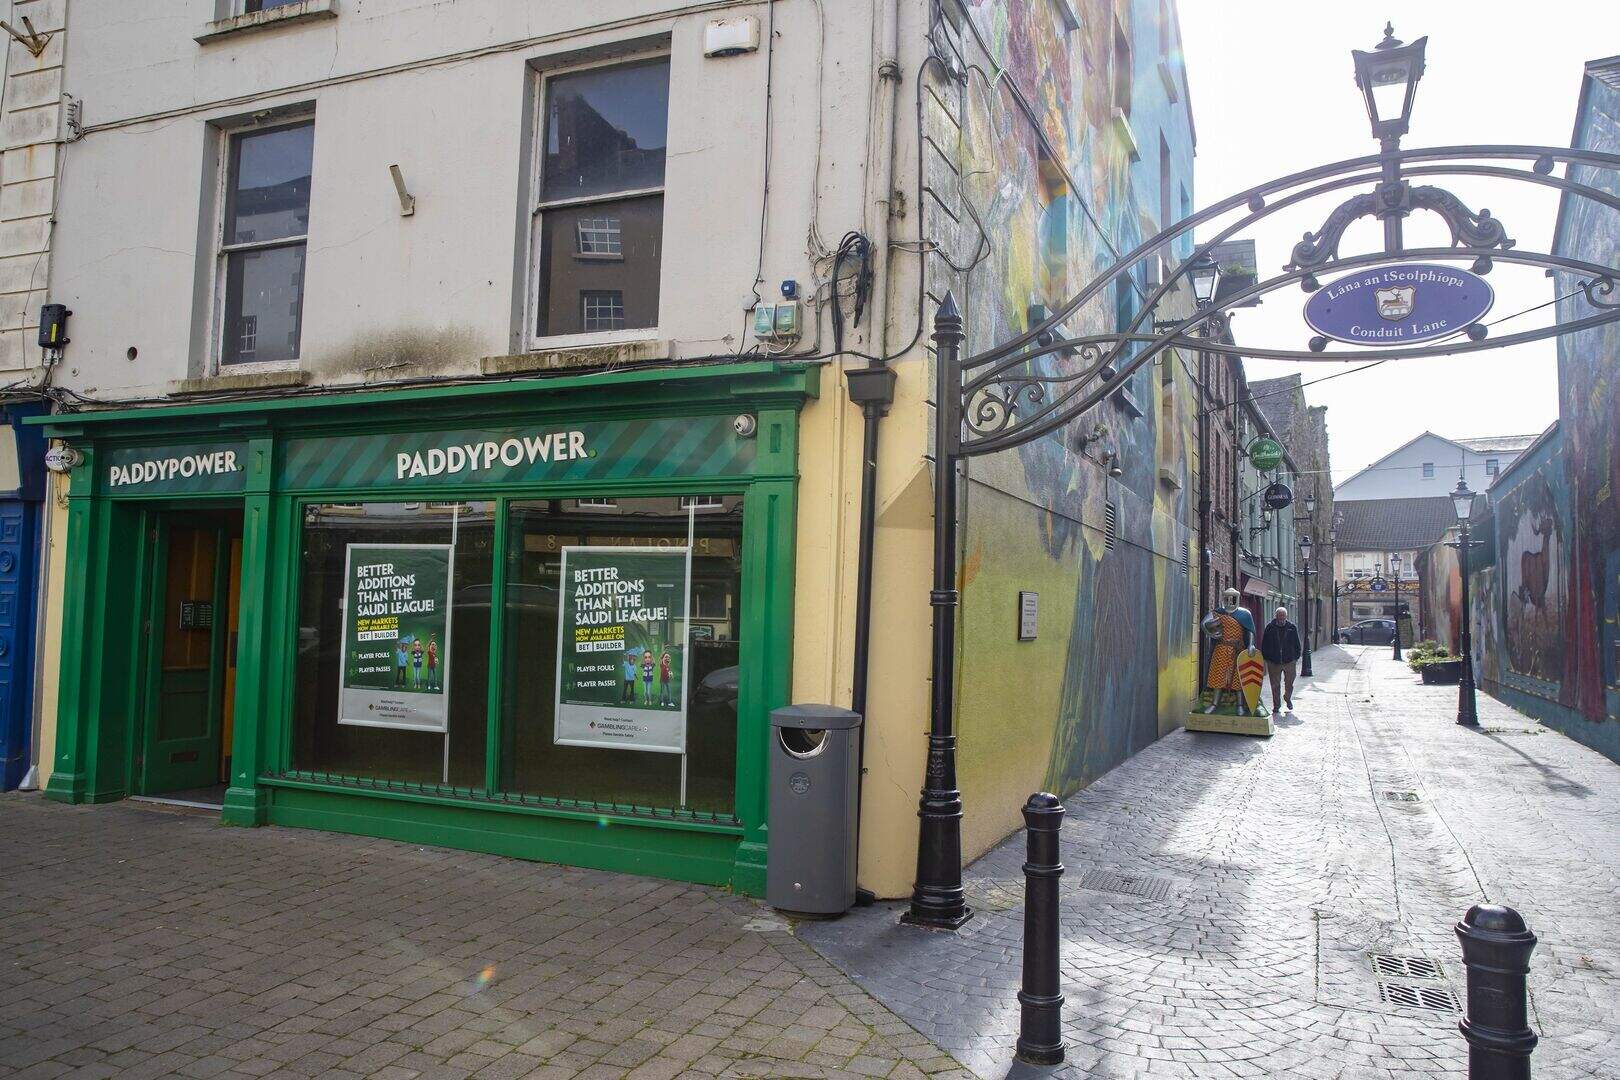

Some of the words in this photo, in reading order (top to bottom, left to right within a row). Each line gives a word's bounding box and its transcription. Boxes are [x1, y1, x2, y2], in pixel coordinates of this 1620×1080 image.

[1327, 281, 1361, 301] Lána
[1364, 276, 1380, 287] an
[1384, 270, 1465, 288] tSeolphíopa
[1350, 325, 1403, 338] Conduit
[1412, 318, 1447, 335] Lane
[357, 563, 394, 578] BETTER
[574, 566, 619, 583] BETTER
[357, 574, 416, 591] ADDITIONS
[575, 579, 645, 598] ADDITIONS
[357, 590, 389, 604] THAN
[393, 588, 413, 601] THE
[575, 596, 613, 611] THAN
[615, 594, 642, 609] THE
[357, 602, 388, 617] SAUDI
[391, 599, 435, 614] LEAGUE!
[357, 619, 370, 627] NEW
[371, 617, 399, 625] MARKETS
[575, 609, 612, 626] SAUDI
[615, 606, 668, 623] LEAGUE!
[360, 632, 370, 640] BET
[374, 630, 397, 639] BUILDER
[575, 628, 591, 636] NEW
[592, 626, 625, 635] MARKETS
[578, 643, 590, 652] BET
[596, 642, 623, 651] BUILDER
[358, 652, 375, 660] PLAYER
[375, 651, 390, 659] FOULS
[358, 666, 375, 674] PLAYER
[375, 665, 391, 673] PASSES
[576, 664, 596, 673] PLAYER
[597, 663, 615, 672] FOULS
[576, 679, 597, 688] PLAYER
[597, 678, 616, 687] PASSES
